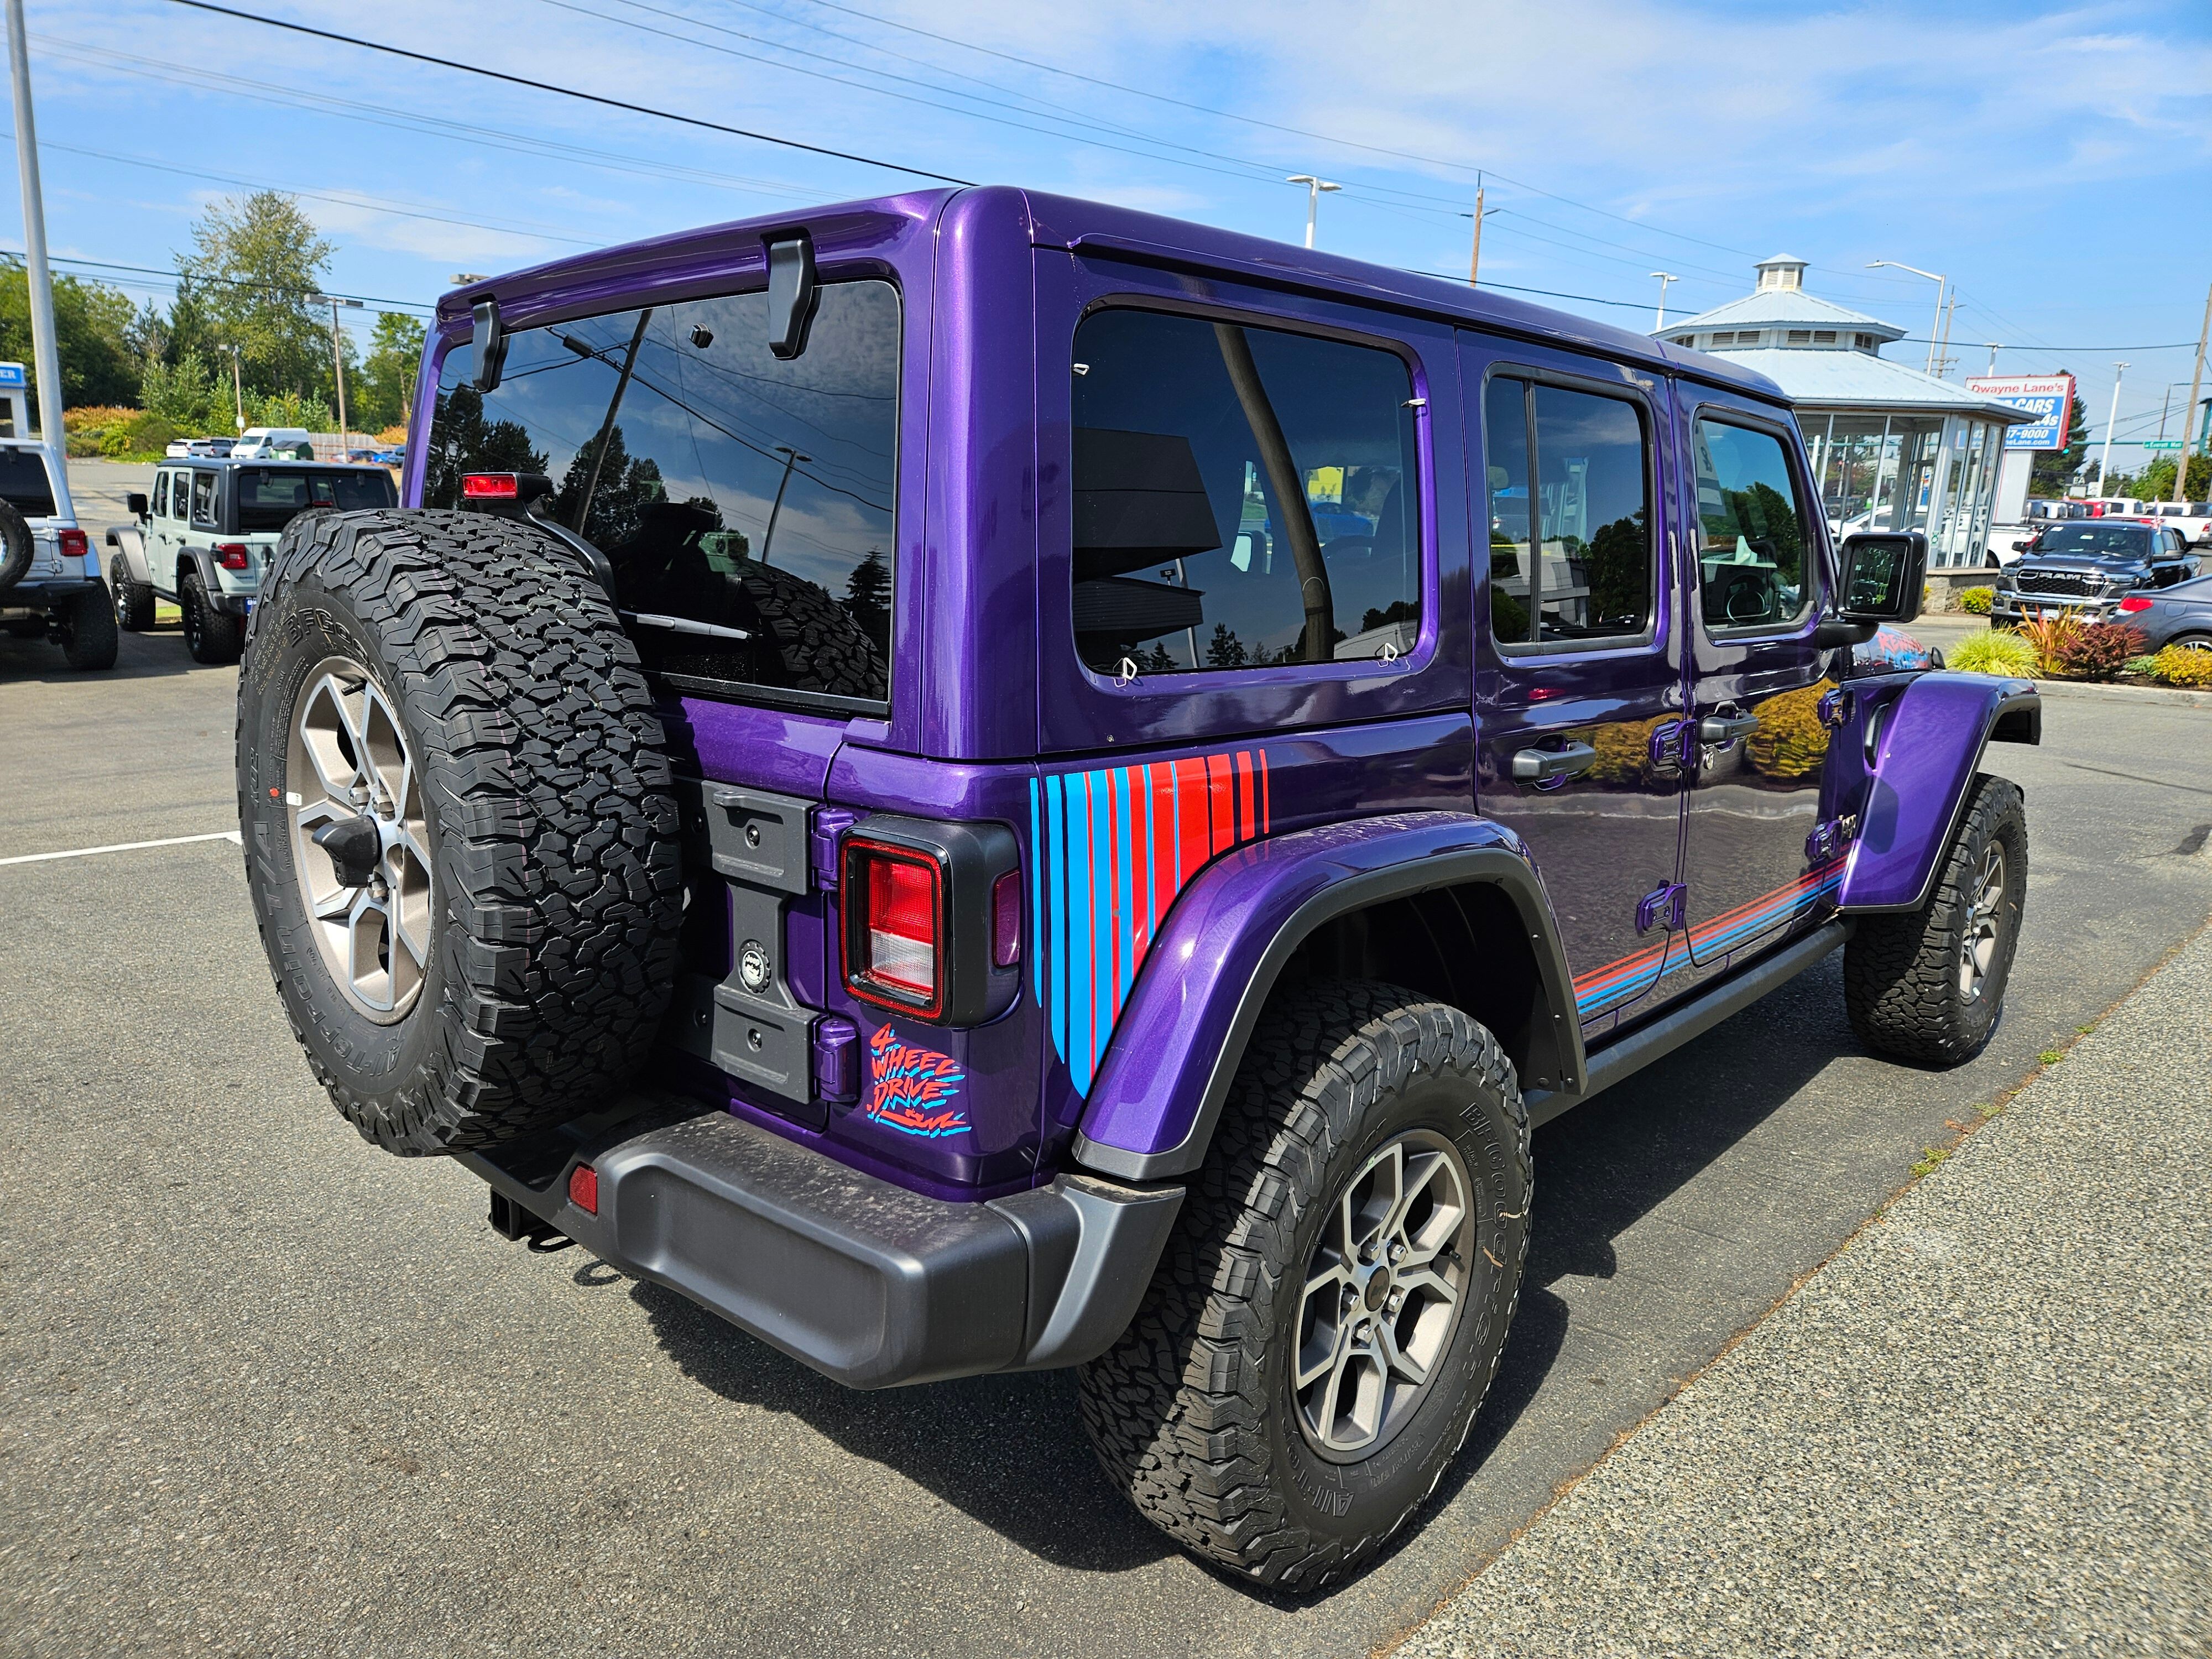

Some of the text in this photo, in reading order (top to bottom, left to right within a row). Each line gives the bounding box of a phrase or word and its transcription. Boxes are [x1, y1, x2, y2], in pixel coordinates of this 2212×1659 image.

[1972, 383, 2063, 395] Dwayne Lane's
[2015, 398, 2055, 414] CARS
[2039, 571, 2082, 581] RAM
[745, 954, 760, 967] Jeep
[870, 1022, 897, 1056] 4
[872, 1046, 961, 1080] WHEEL
[873, 1076, 952, 1114] DRIVE
